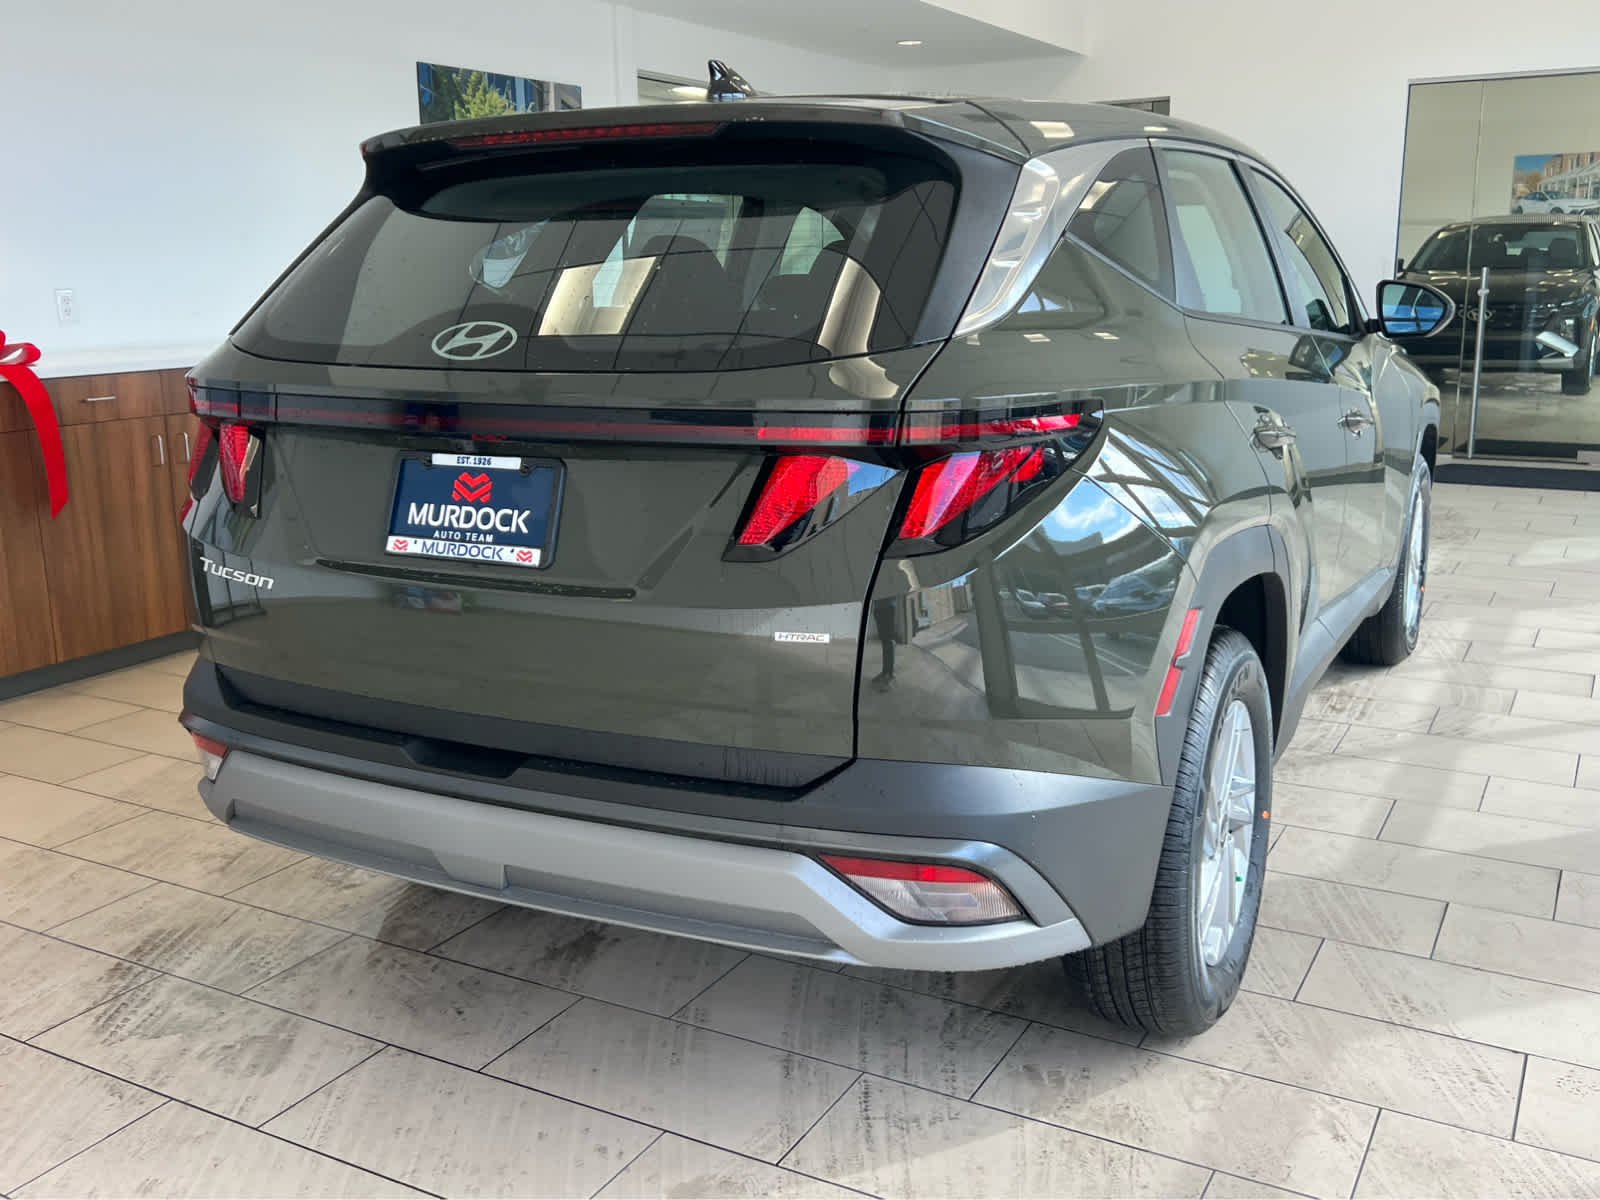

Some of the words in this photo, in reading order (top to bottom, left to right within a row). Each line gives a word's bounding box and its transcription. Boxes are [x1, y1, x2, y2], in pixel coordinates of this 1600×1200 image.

[473, 457, 492, 466] 1926
[407, 502, 531, 534] MURDOCK
[433, 530, 461, 541] AUTO
[466, 532, 494, 543] TEAM
[420, 540, 504, 560] MURDOCK
[777, 632, 825, 642] HTRAC
